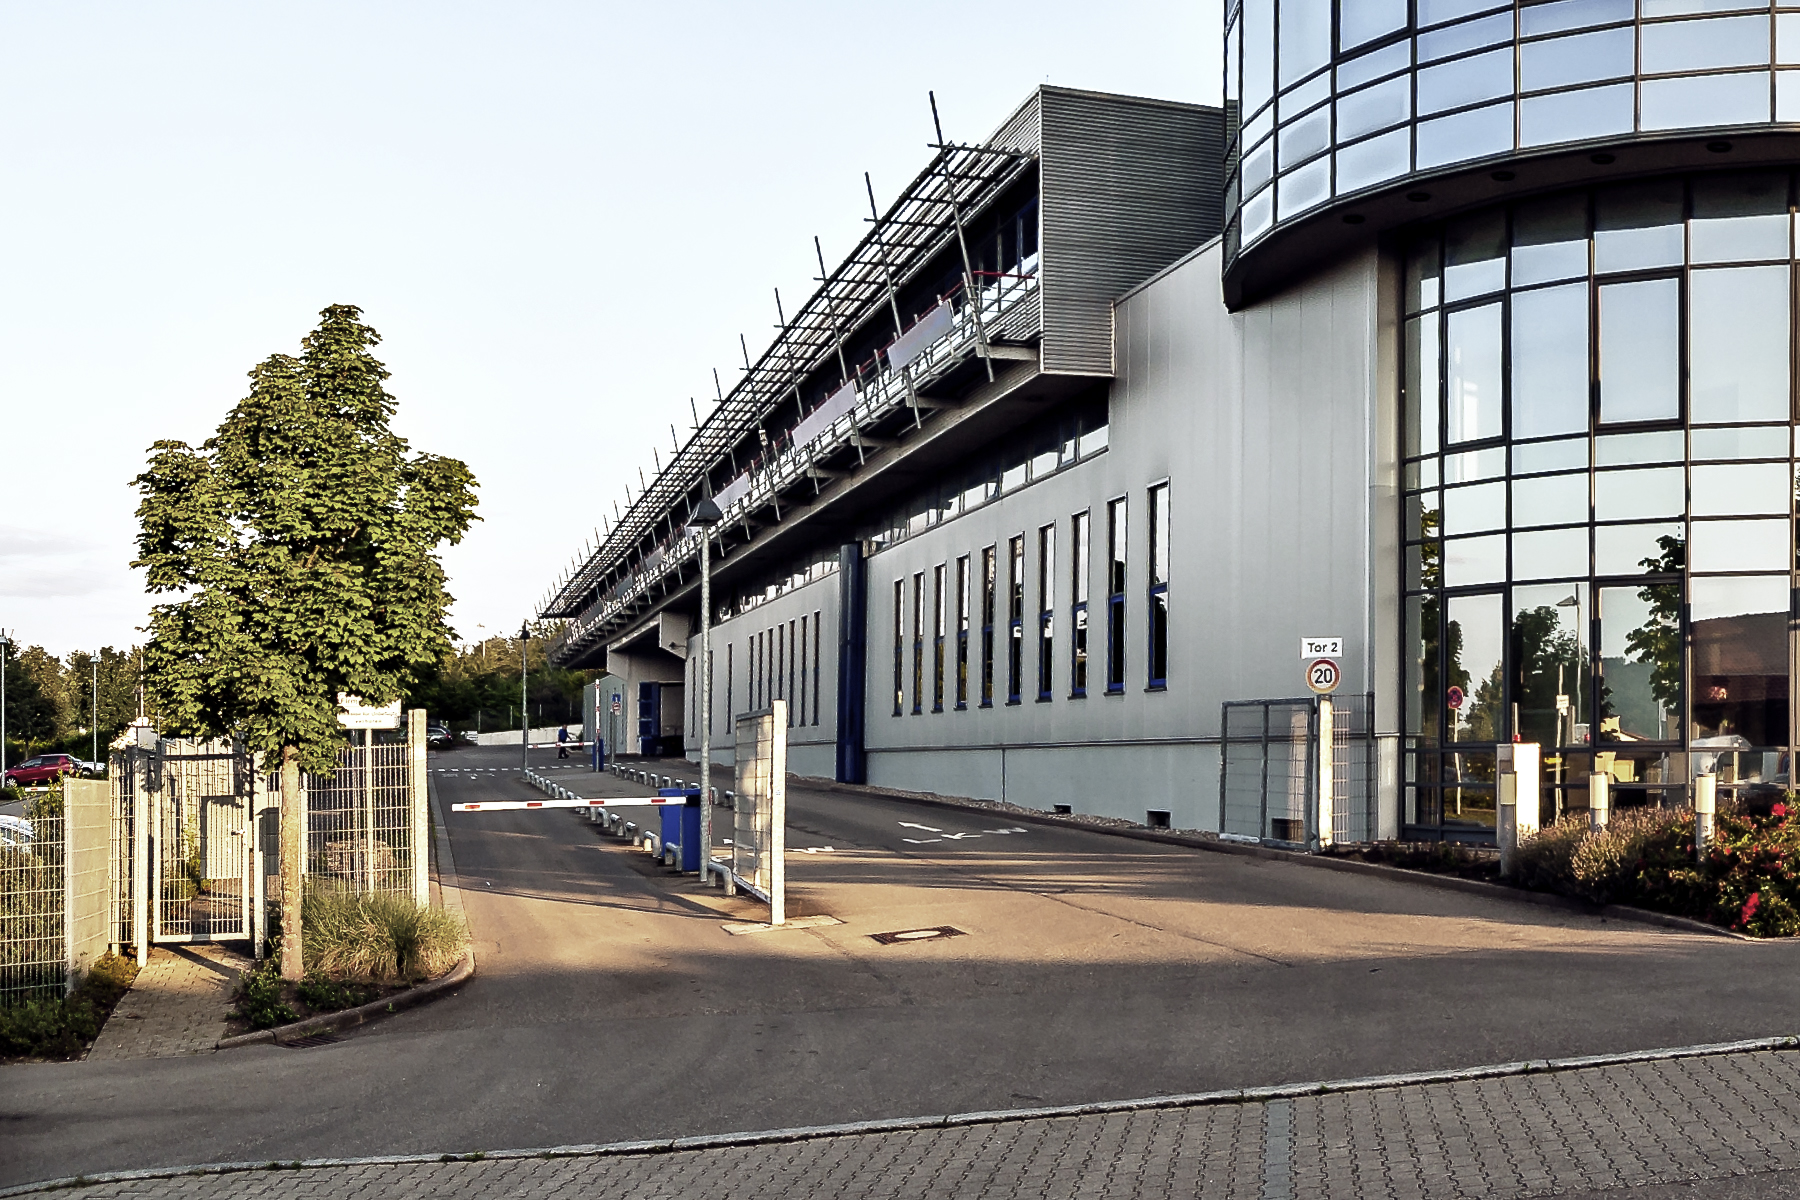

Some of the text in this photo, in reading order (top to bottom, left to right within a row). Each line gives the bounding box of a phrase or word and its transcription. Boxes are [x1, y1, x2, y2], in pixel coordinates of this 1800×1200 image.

[1307, 642, 1338, 653] Tor 2
[1313, 668, 1333, 685] 20
